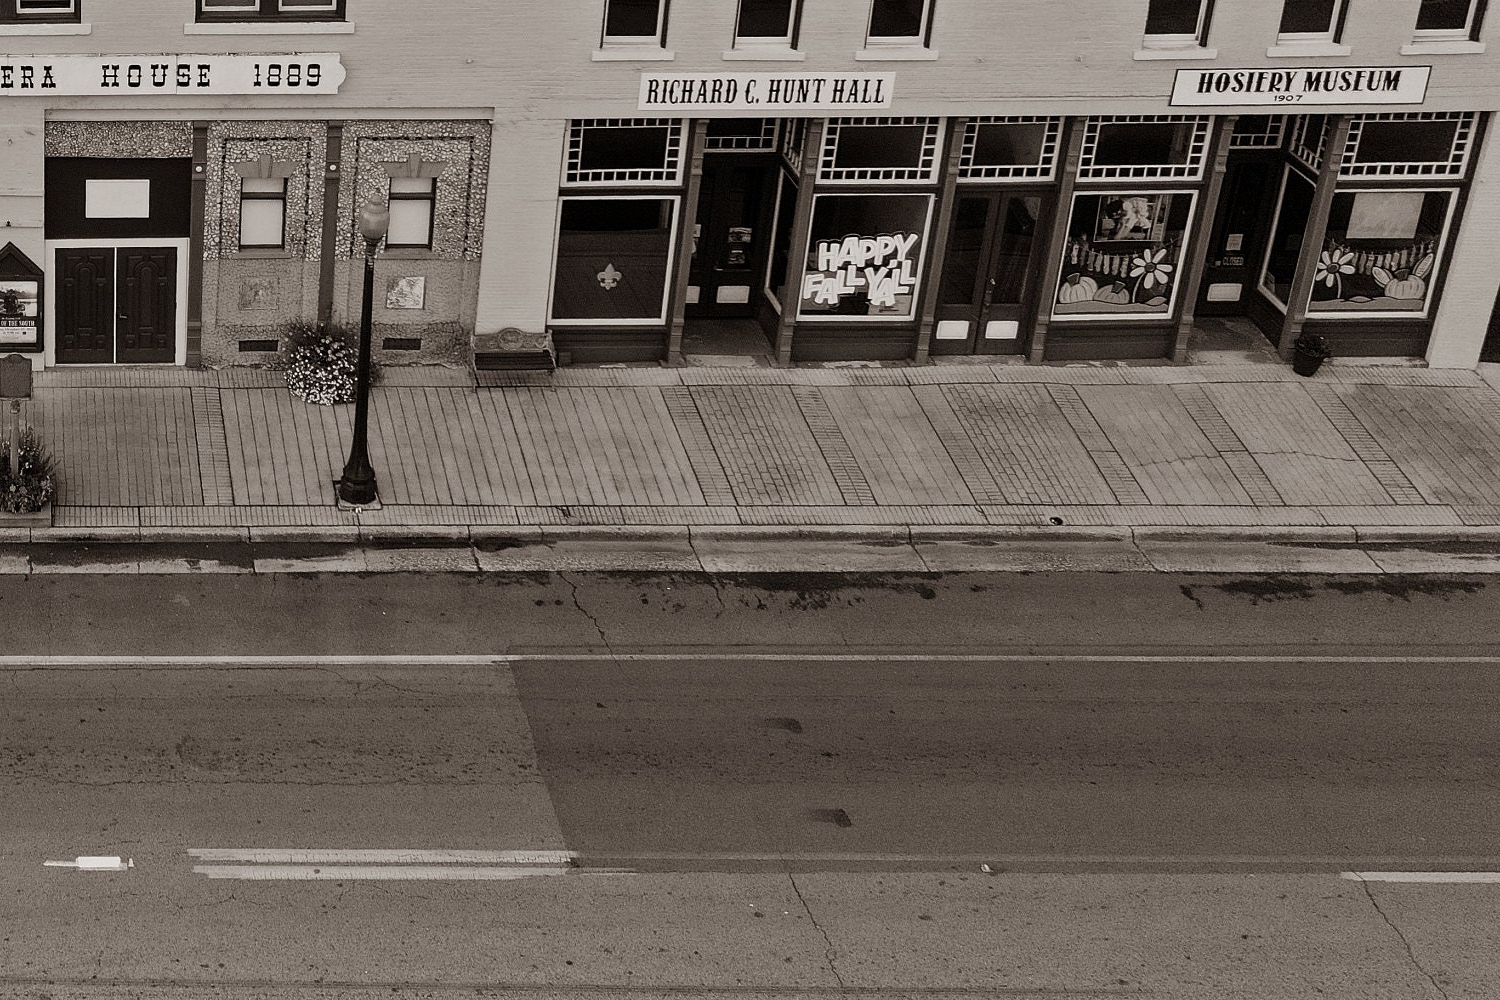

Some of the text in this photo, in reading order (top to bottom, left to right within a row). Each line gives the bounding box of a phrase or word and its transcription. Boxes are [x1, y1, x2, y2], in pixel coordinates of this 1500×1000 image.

[100, 63, 211, 88] HOUSE
[253, 63, 322, 87] 1889
[1196, 69, 1403, 94] HOSIERY MUSEUM
[645, 78, 886, 105] RICHARD C. HUNT HALL
[1273, 94, 1304, 102] 1907
[817, 233, 919, 272] HAPPY
[802, 259, 917, 307] FALL Y'ALL
